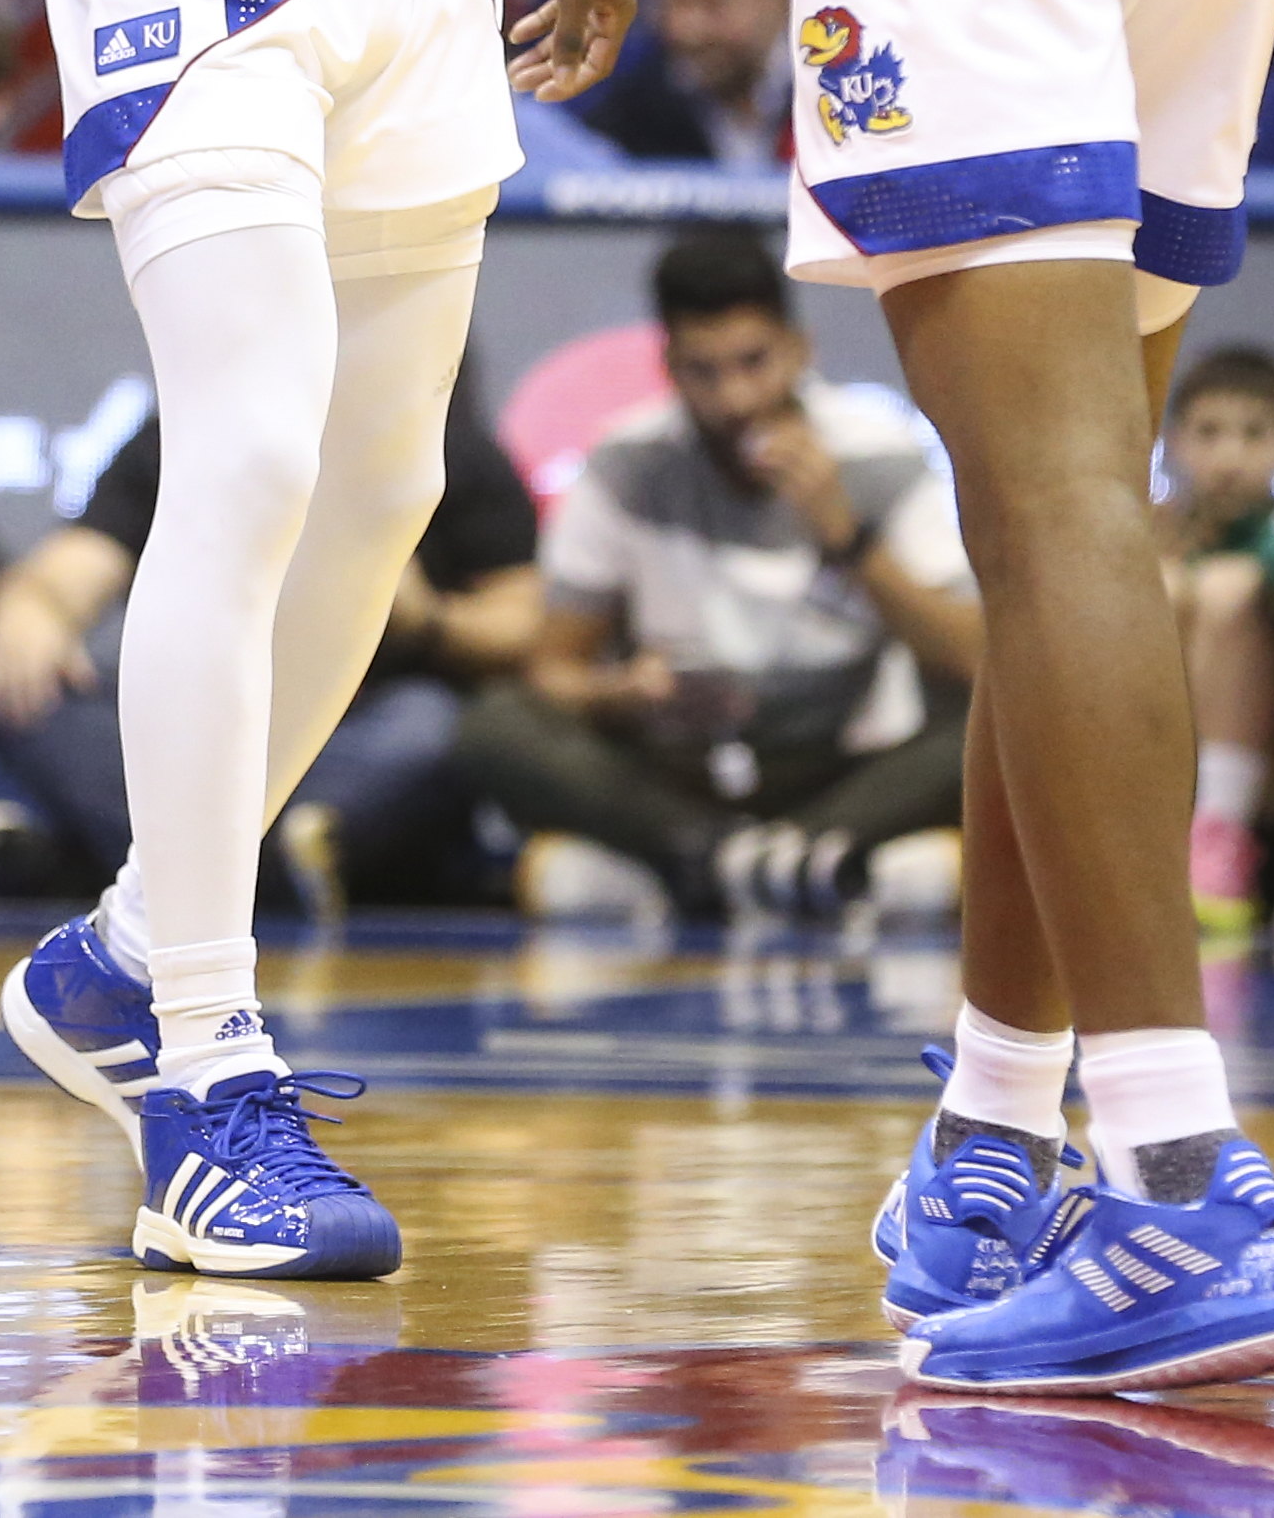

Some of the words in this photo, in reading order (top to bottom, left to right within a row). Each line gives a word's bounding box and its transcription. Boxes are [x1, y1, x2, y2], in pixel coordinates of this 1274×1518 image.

[143, 19, 176, 48] KU
[98, 46, 137, 66] adidas
[839, 71, 875, 105] KU
